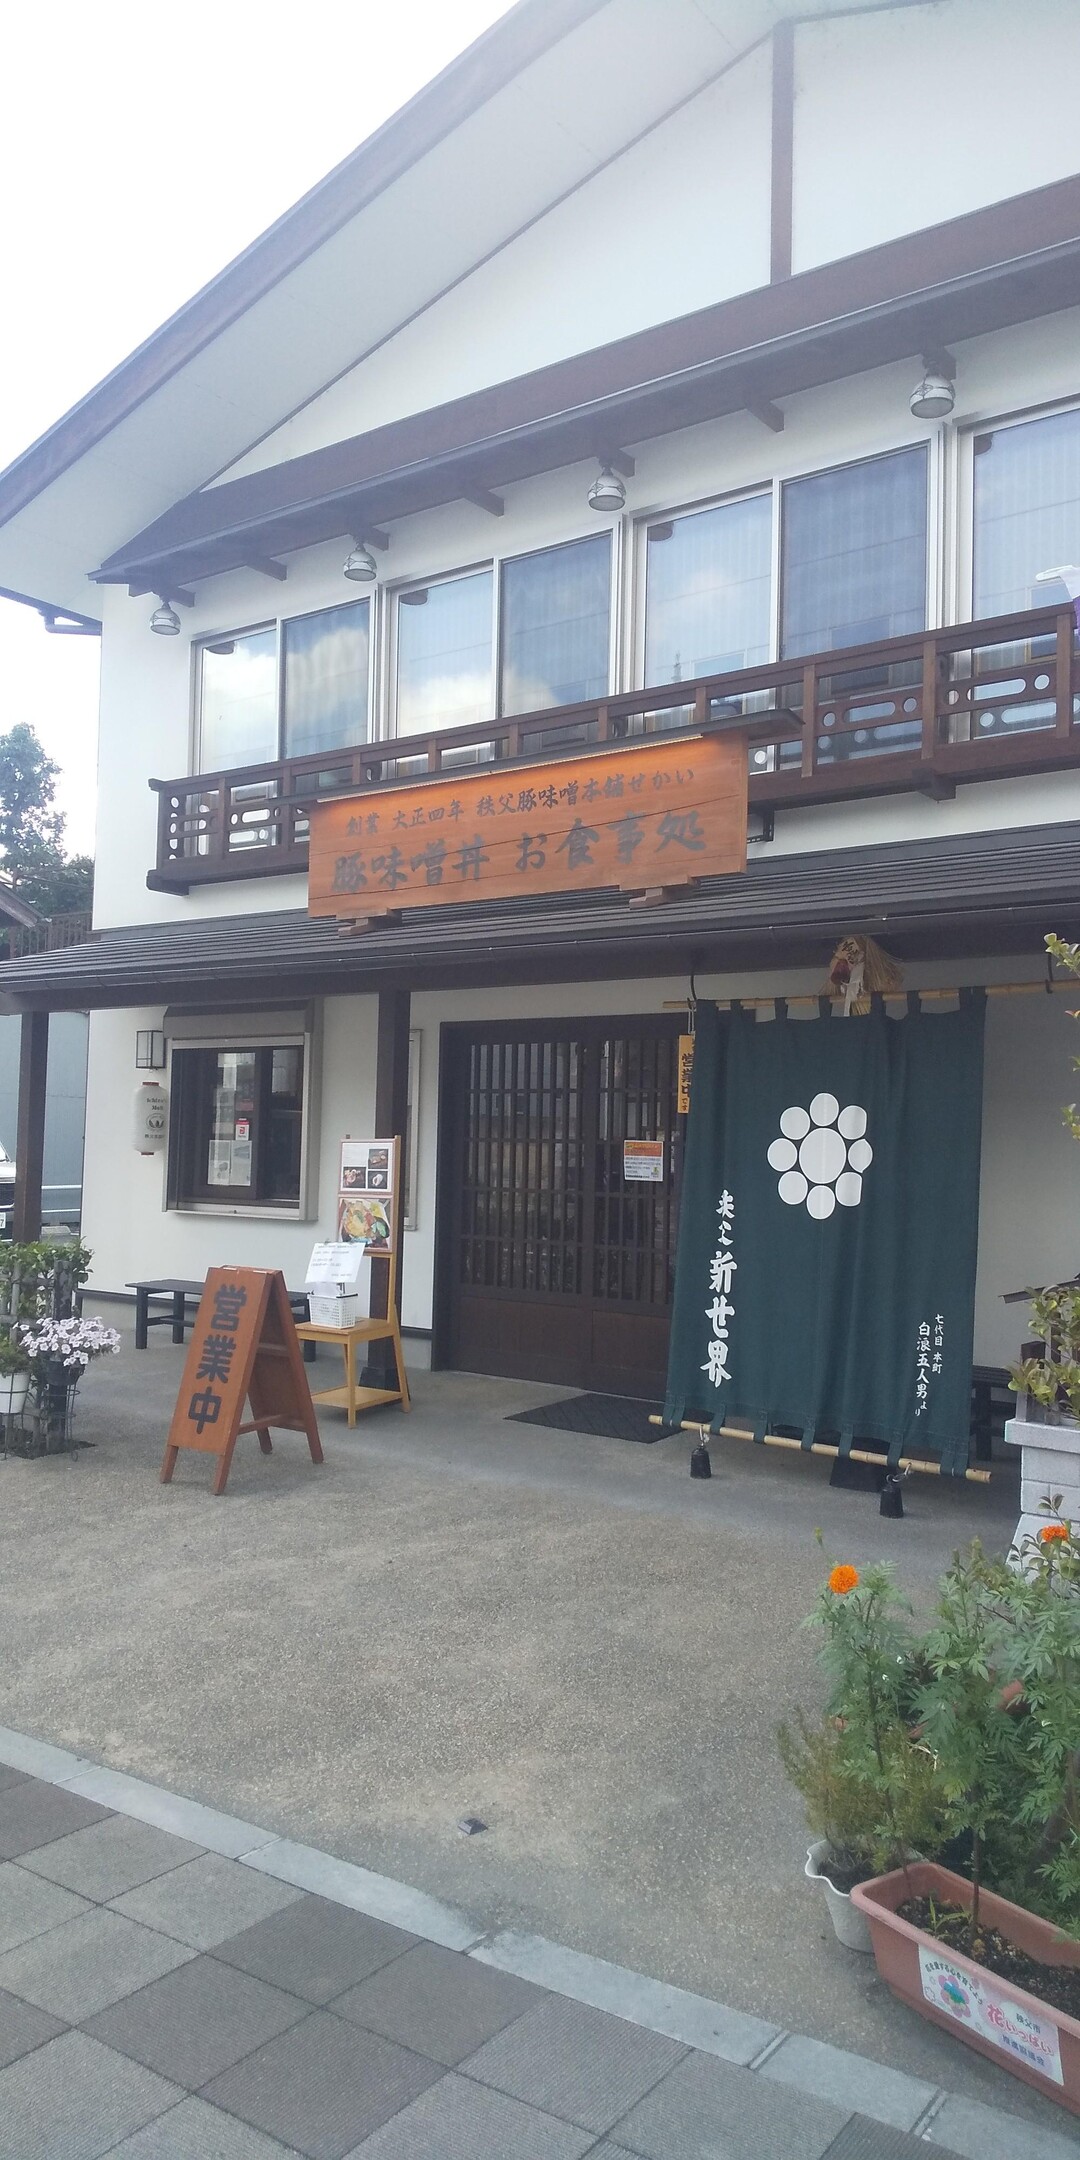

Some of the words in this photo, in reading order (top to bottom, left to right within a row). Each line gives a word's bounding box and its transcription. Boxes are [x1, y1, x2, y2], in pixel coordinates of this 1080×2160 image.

[346, 811, 380, 836] 創業
[393, 799, 464, 829] 大正四年
[476, 768, 695, 817] 秩父豚味噌本舗せかい
[332, 833, 490, 893] 豚味噌丼
[515, 809, 707, 873] お食事処
[934, 1313, 944, 1347] 七代目
[188, 1284, 247, 1434] 営業中
[932, 1351, 943, 1374] 本町
[986, 2002, 1054, 2055] 花いっぱい
[1016, 2013, 1041, 2034] 秩父市
